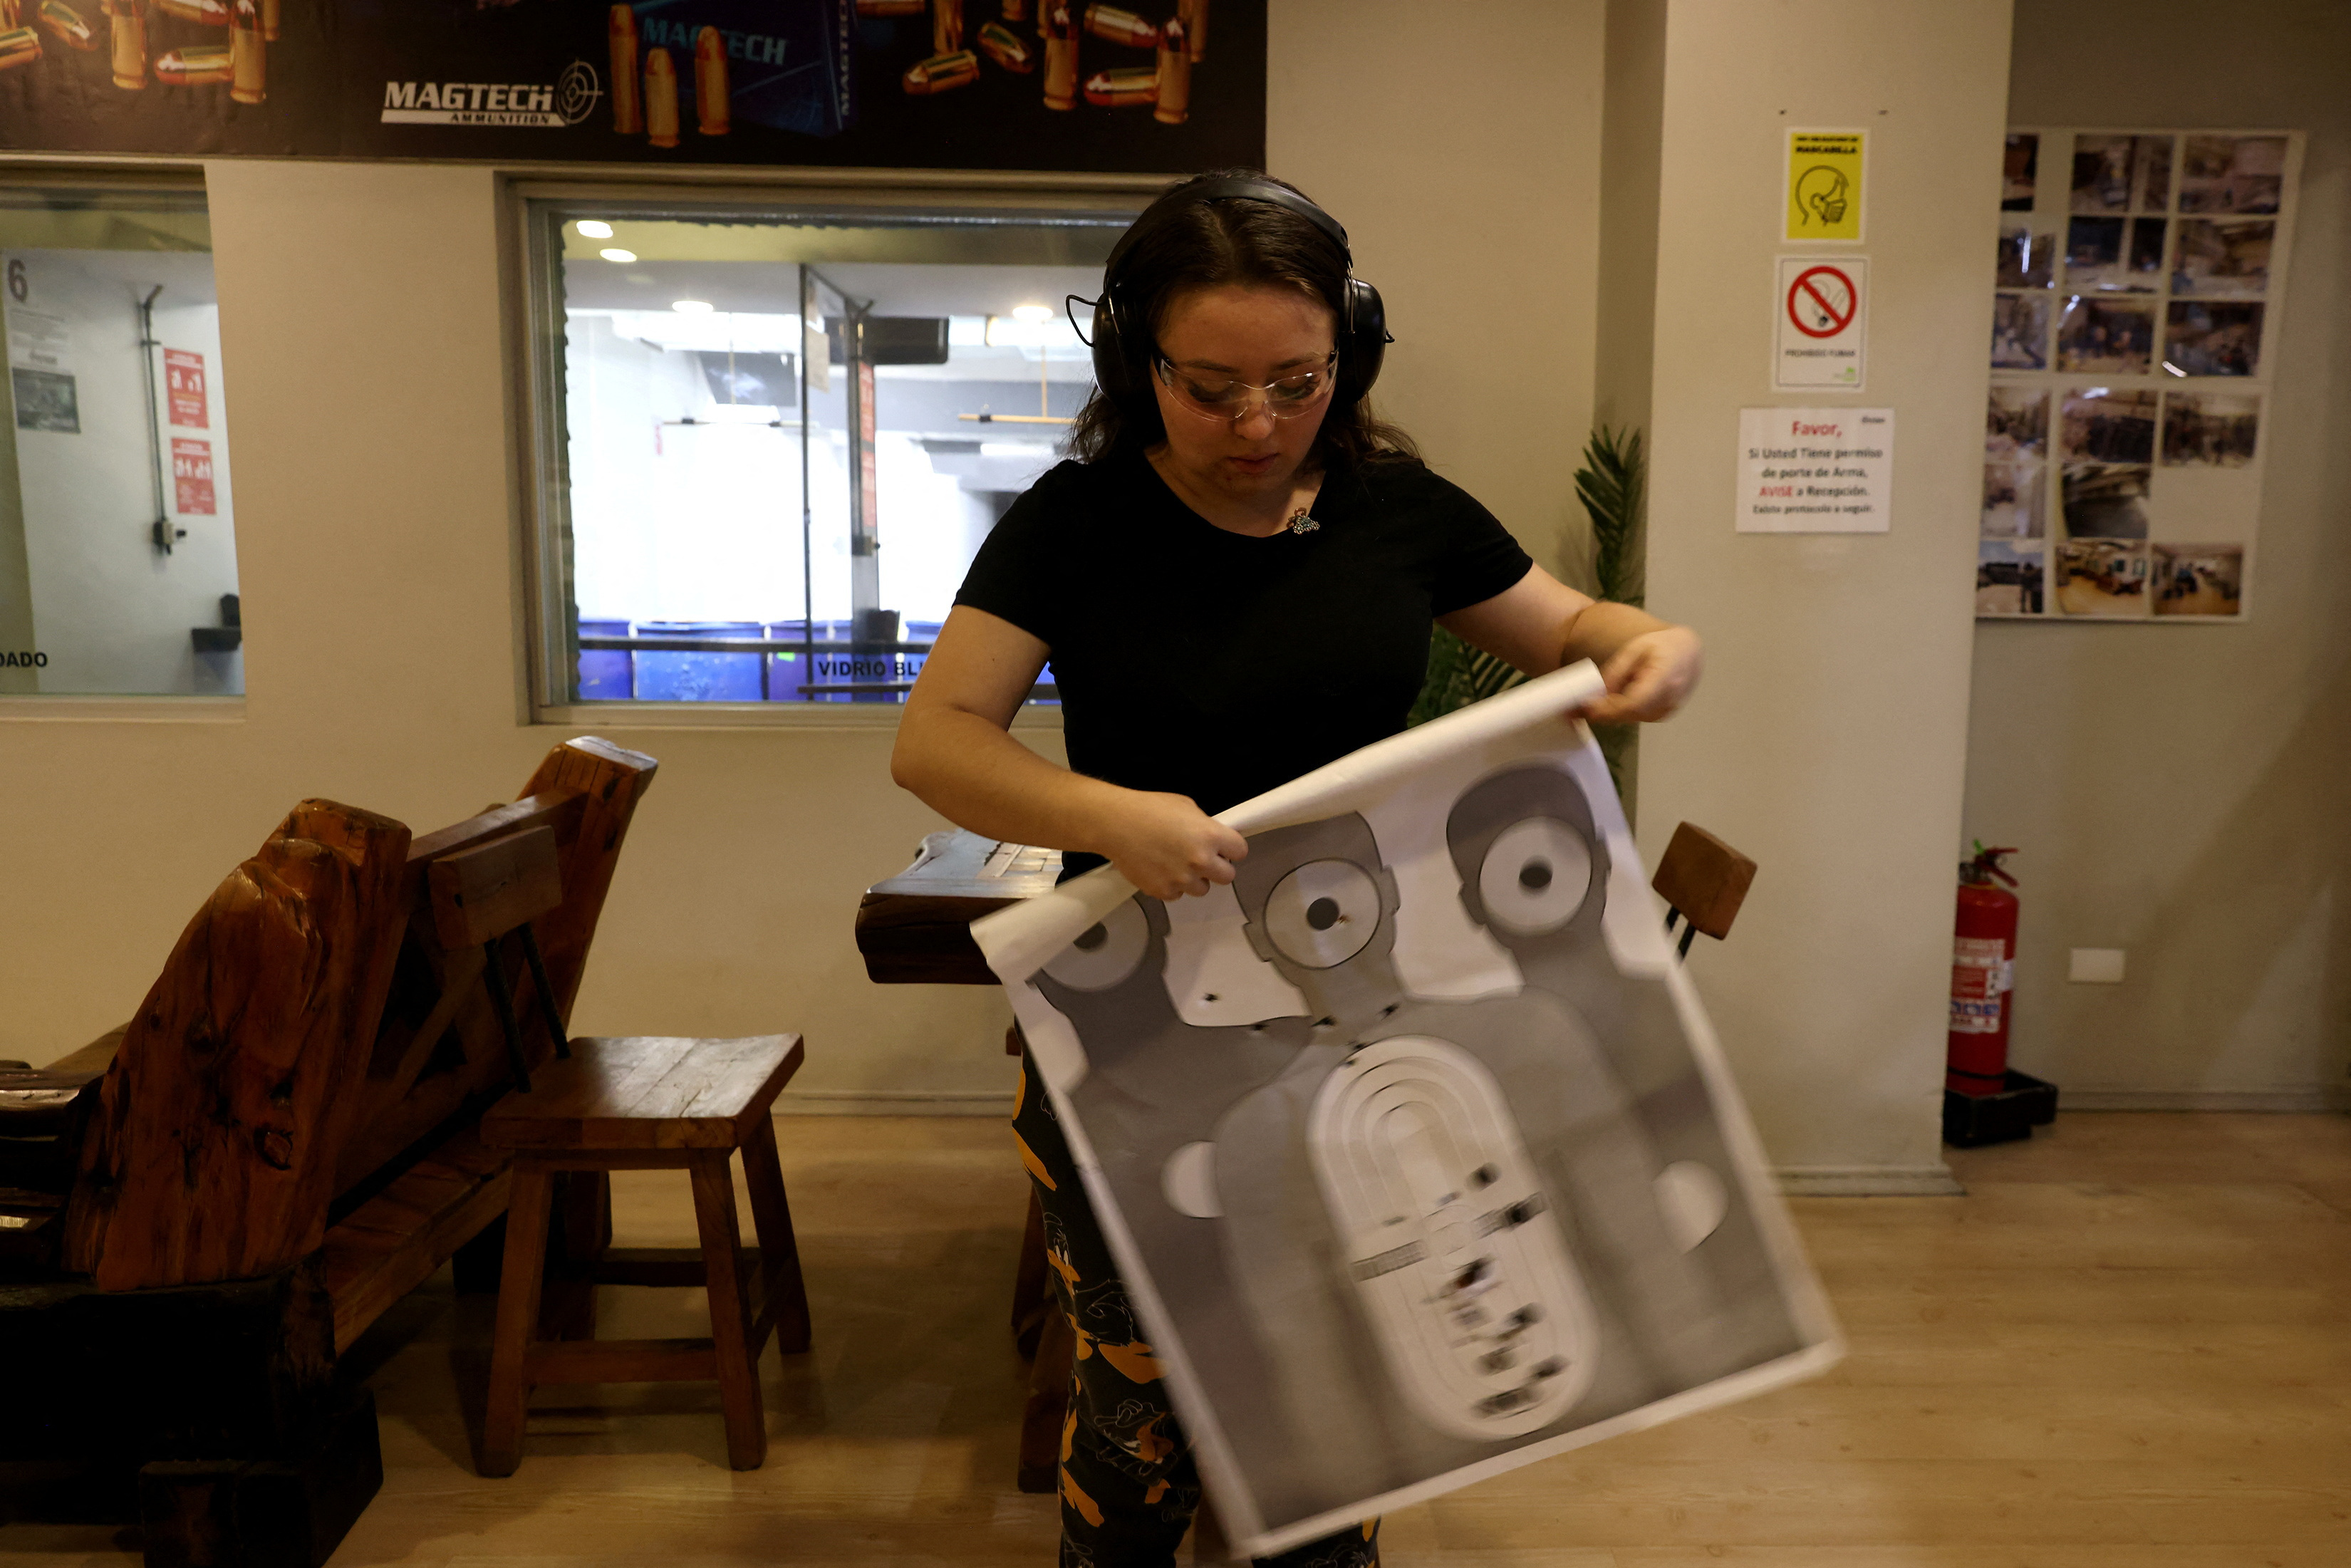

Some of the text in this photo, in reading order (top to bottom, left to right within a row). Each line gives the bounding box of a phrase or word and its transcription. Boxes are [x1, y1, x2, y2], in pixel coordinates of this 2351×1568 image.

[643, 17, 787, 66] MAECH
[839, 0, 850, 115] MAGTEC
[384, 81, 554, 110] MAGTECH
[450, 113, 550, 124] AMMUNITION
[7, 259, 28, 303] 6
[1791, 420, 1842, 438] Favor,
[1748, 447, 1884, 460] Si Usted Tiene permiso
[1761, 467, 1777, 478] de
[1780, 468, 1812, 479] porte
[1815, 467, 1830, 478] de
[1759, 486, 1792, 497] AVISE
[1796, 488, 1804, 497] a
[818, 661, 886, 676] VIDRIO
